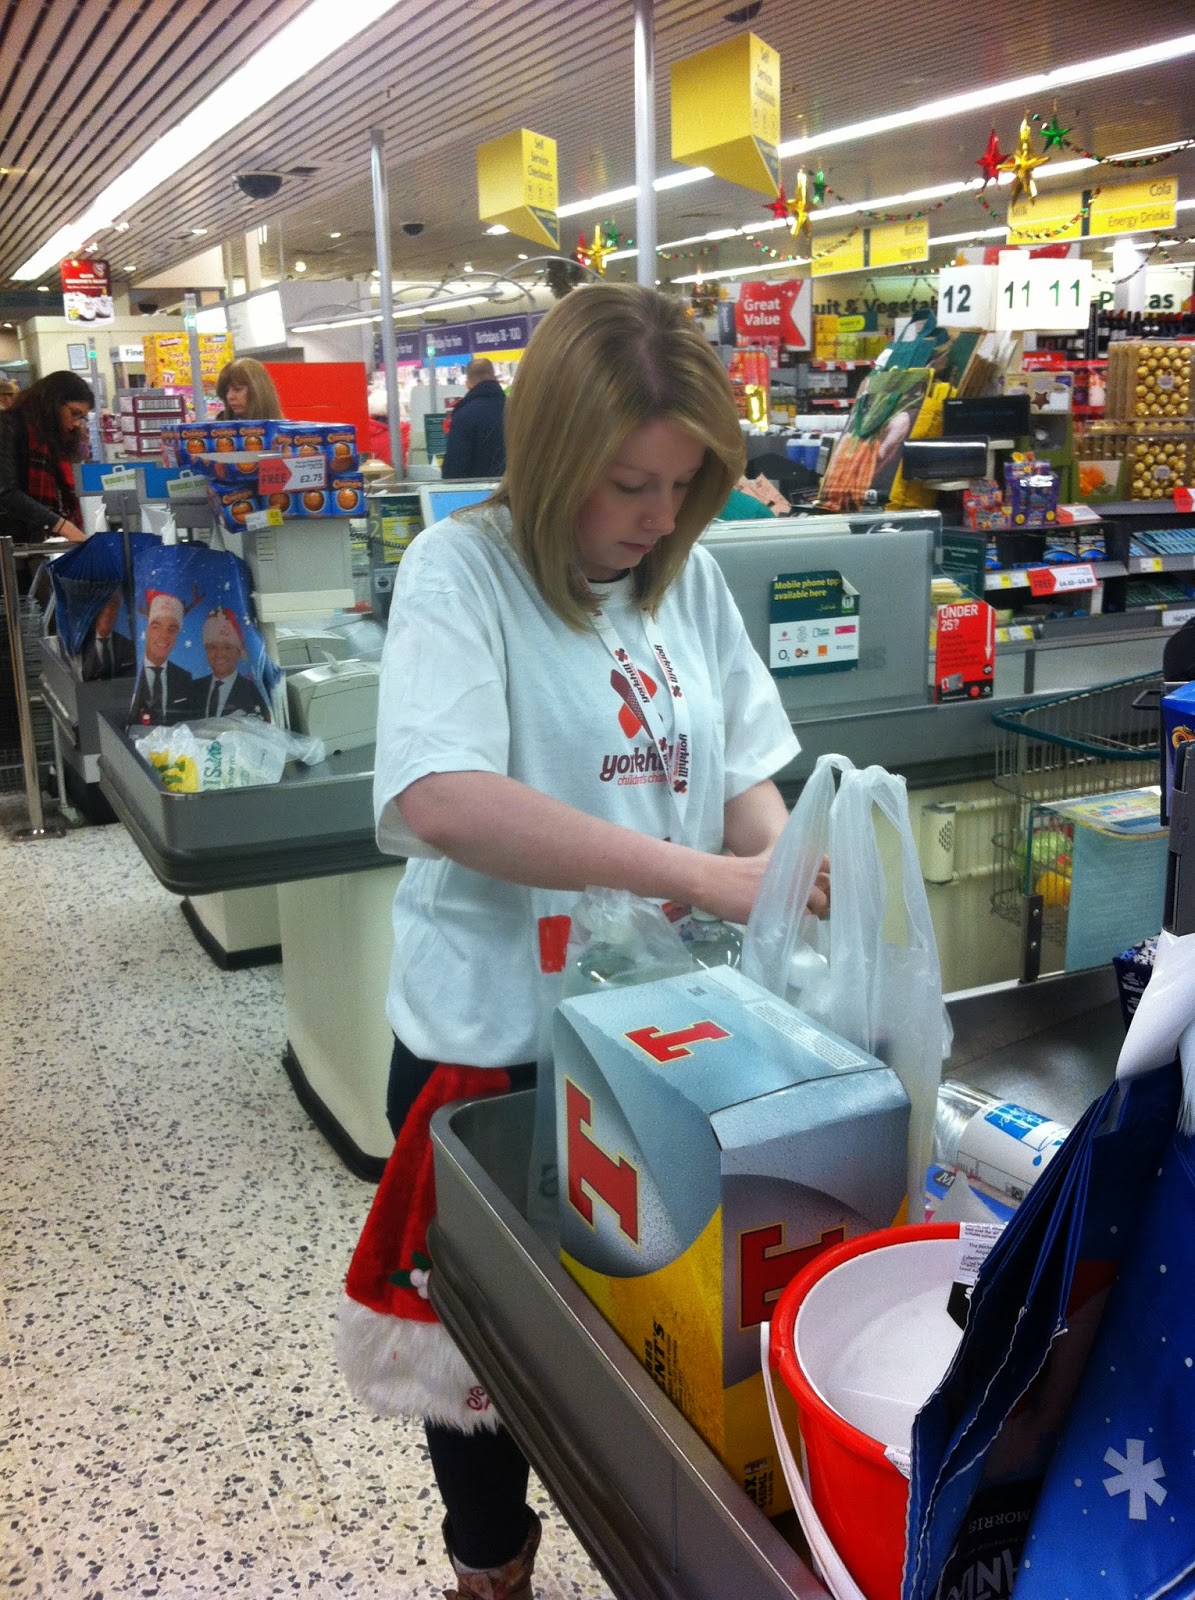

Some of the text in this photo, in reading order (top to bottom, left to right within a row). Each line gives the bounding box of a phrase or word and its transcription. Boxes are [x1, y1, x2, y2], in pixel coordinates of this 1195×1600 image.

[1149, 182, 1172, 197] Cola
[1107, 209, 1171, 228] Energy Drinks
[743, 298, 781, 312] Great
[943, 284, 971, 314] 12
[743, 312, 781, 326] Value
[262, 473, 286, 484] FREE
[300, 473, 322, 483] £2.75
[774, 580, 802, 590] Mobile
[802, 579, 826, 589] phone
[774, 589, 827, 601] available here
[940, 604, 979, 620] UNDER
[940, 619, 960, 632] 25?
[935, 1172, 956, 1187] M
